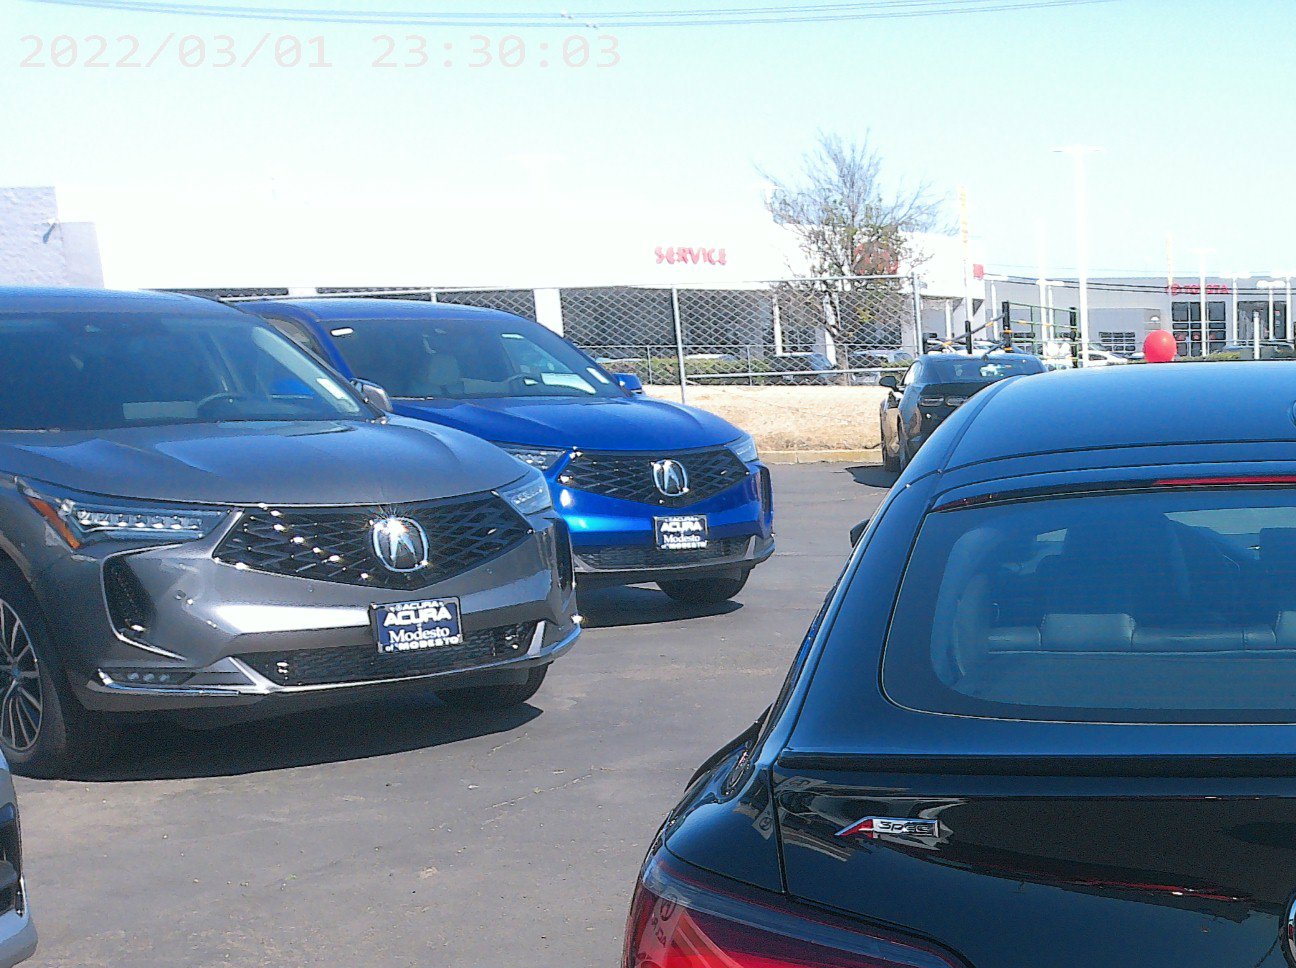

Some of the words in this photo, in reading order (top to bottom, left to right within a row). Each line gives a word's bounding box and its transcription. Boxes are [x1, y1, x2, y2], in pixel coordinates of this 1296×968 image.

[654, 246, 727, 265] SERVICE
[660, 521, 703, 532] ACURA
[383, 607, 452, 627] ACURA
[388, 627, 450, 643] Modesto
[398, 636, 459, 651] MODESTO
